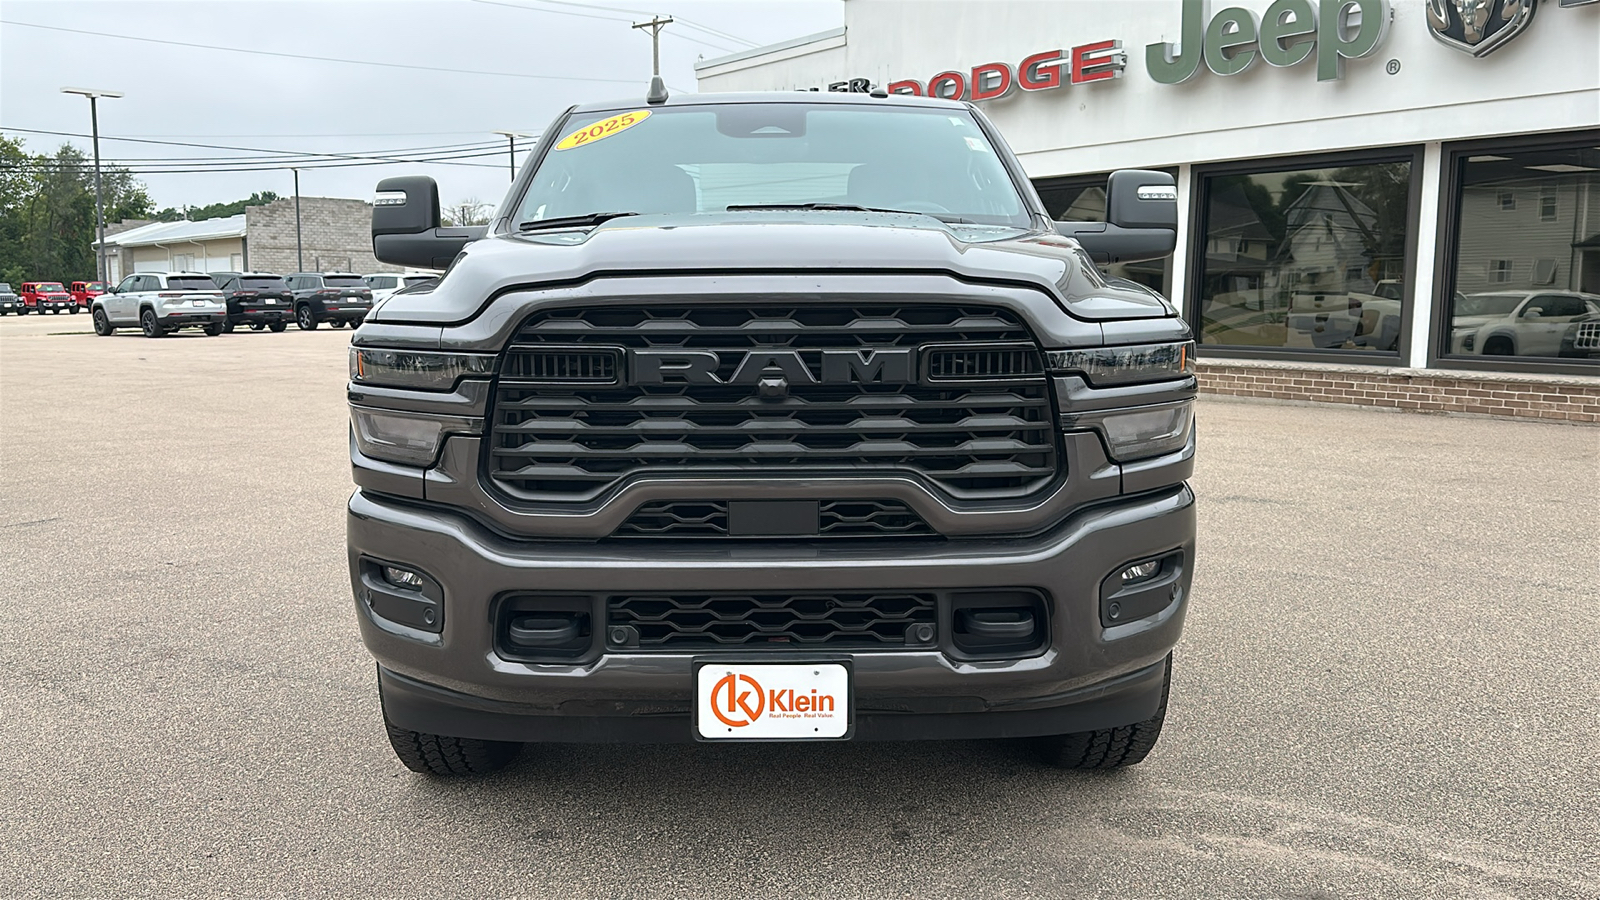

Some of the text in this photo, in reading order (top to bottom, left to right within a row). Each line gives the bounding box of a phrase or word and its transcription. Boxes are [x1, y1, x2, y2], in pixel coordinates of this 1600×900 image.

[1146, 0, 1388, 83] Jeep
[574, 113, 635, 145] 2025
[633, 348, 912, 385] RAM
[769, 689, 835, 712] Klein
